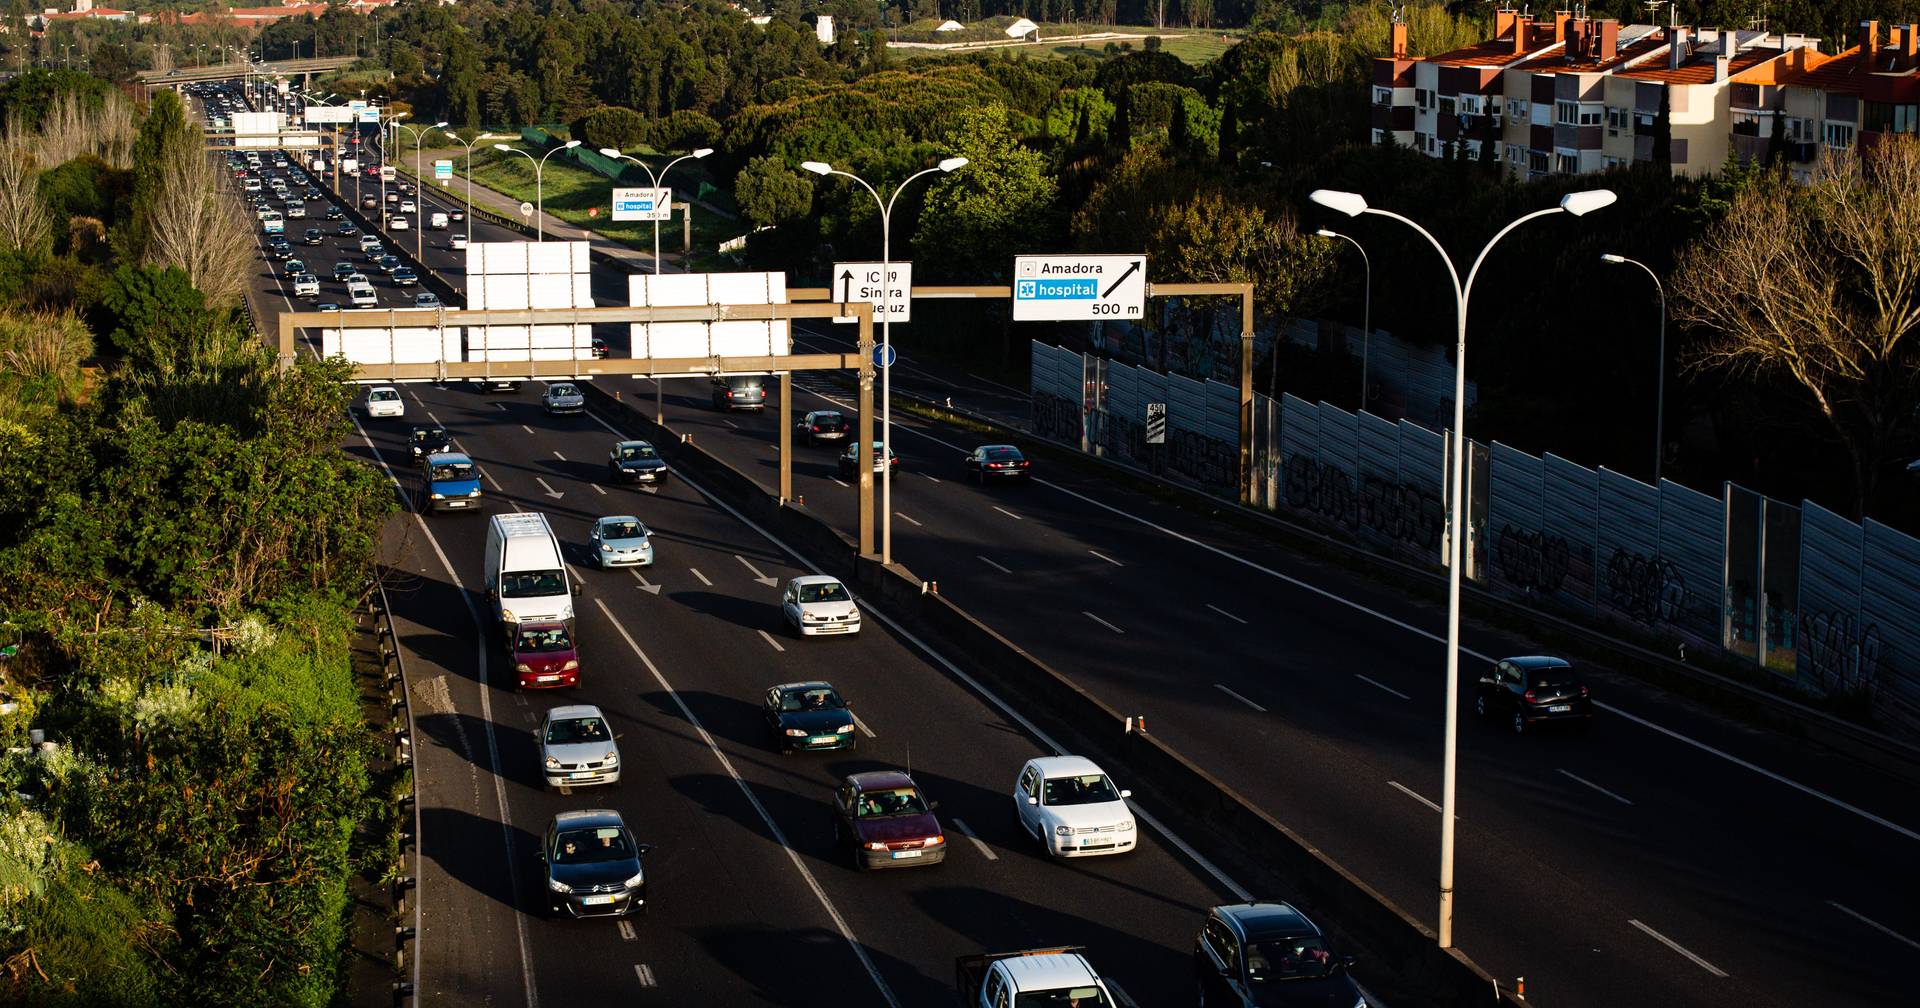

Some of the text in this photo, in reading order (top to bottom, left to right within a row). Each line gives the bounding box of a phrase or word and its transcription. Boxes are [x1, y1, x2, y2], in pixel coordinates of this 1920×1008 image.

[1041, 262, 1103, 274] Amadora
[866, 271, 897, 283] IC 19
[860, 287, 902, 298] Sinra
[1039, 283, 1096, 297] hospital
[1092, 303, 1139, 315] 500 m
[1149, 403, 1164, 412] 450
